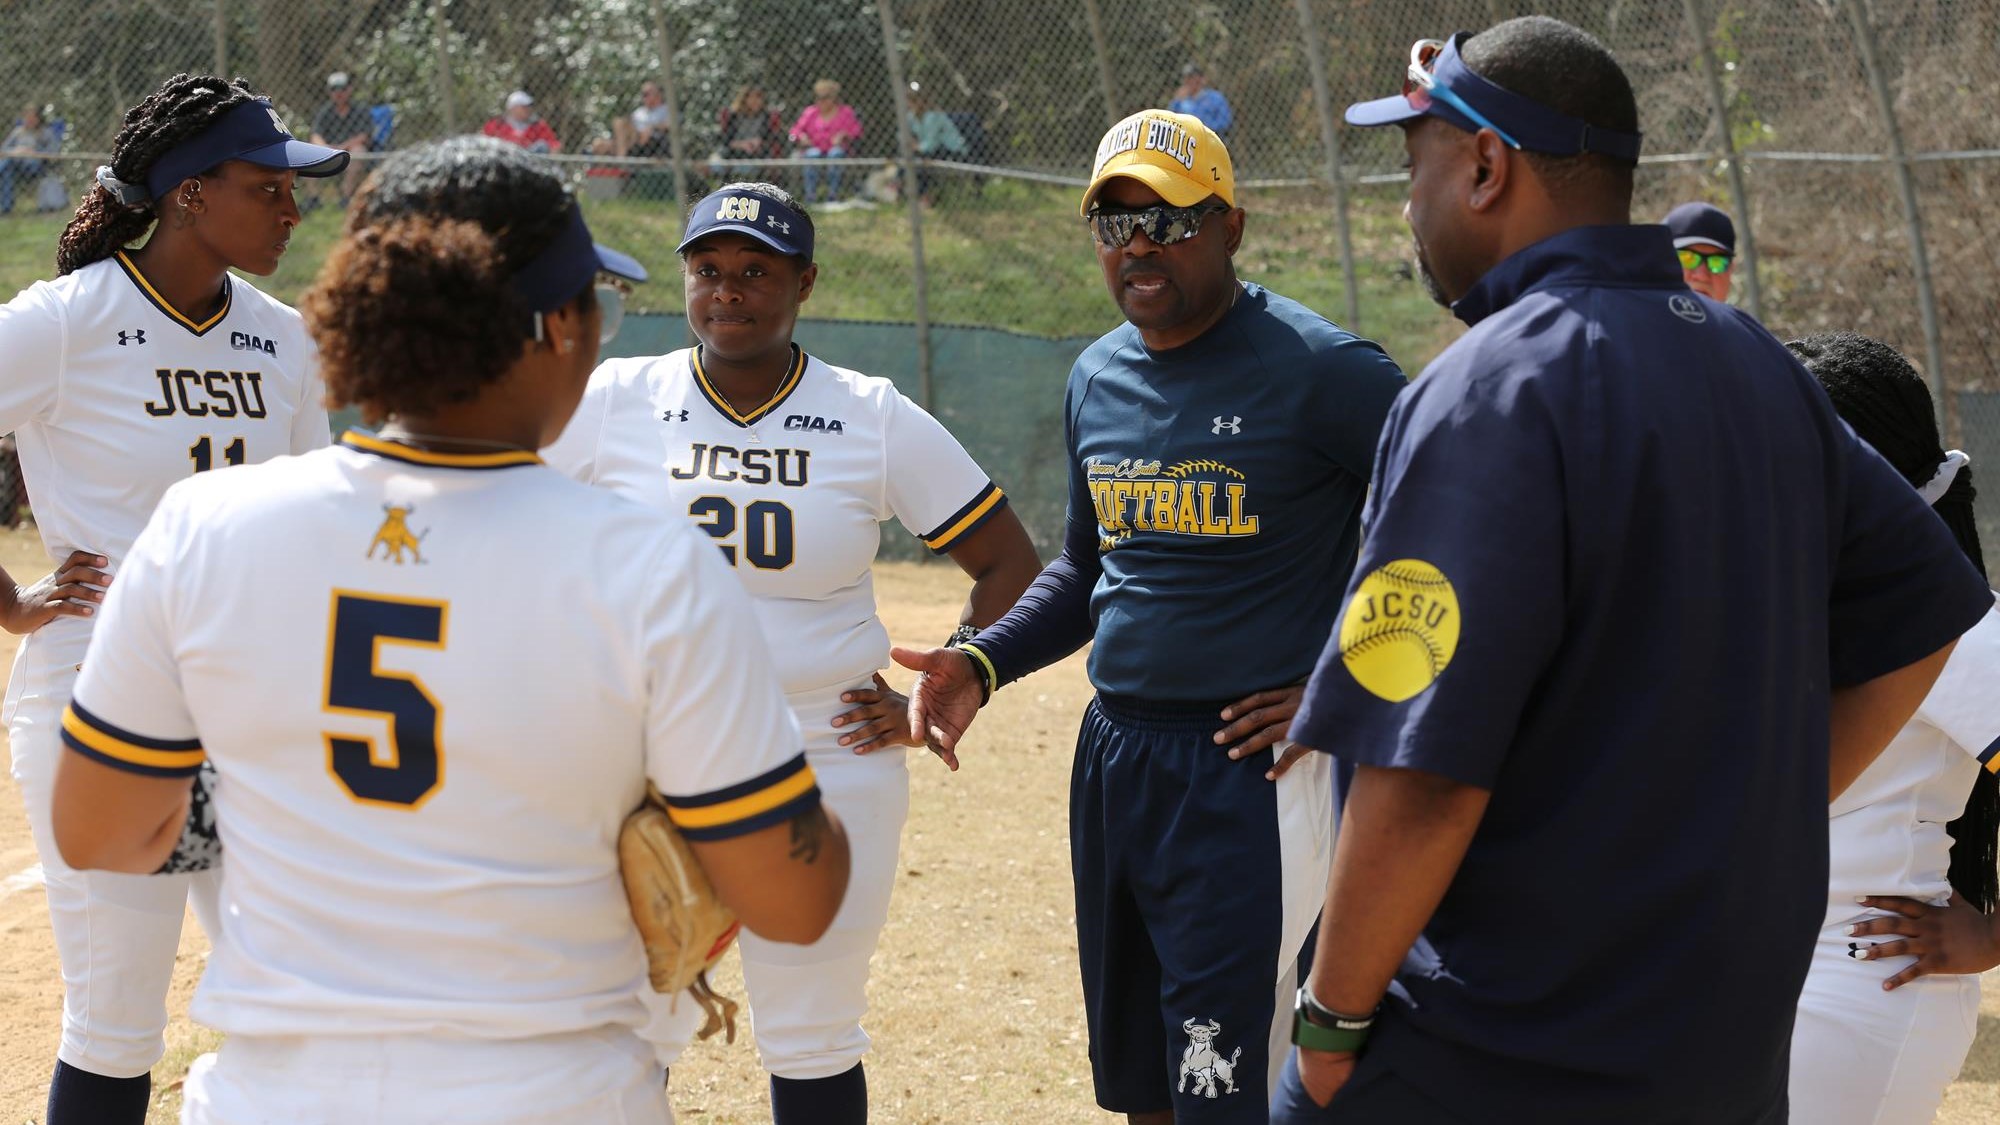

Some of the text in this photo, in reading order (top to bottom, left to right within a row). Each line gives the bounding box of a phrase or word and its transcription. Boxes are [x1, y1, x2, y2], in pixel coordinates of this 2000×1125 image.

[1145, 119, 1196, 171] BULLS
[716, 197, 760, 221] JCSU
[231, 331, 277, 358] CIAA
[144, 368, 268, 419] JCSU
[783, 414, 844, 435] CIAA
[671, 442, 811, 487] JCSU
[688, 494, 796, 572] 20
[1362, 592, 1448, 628] JCSU
[320, 586, 450, 814] 5
